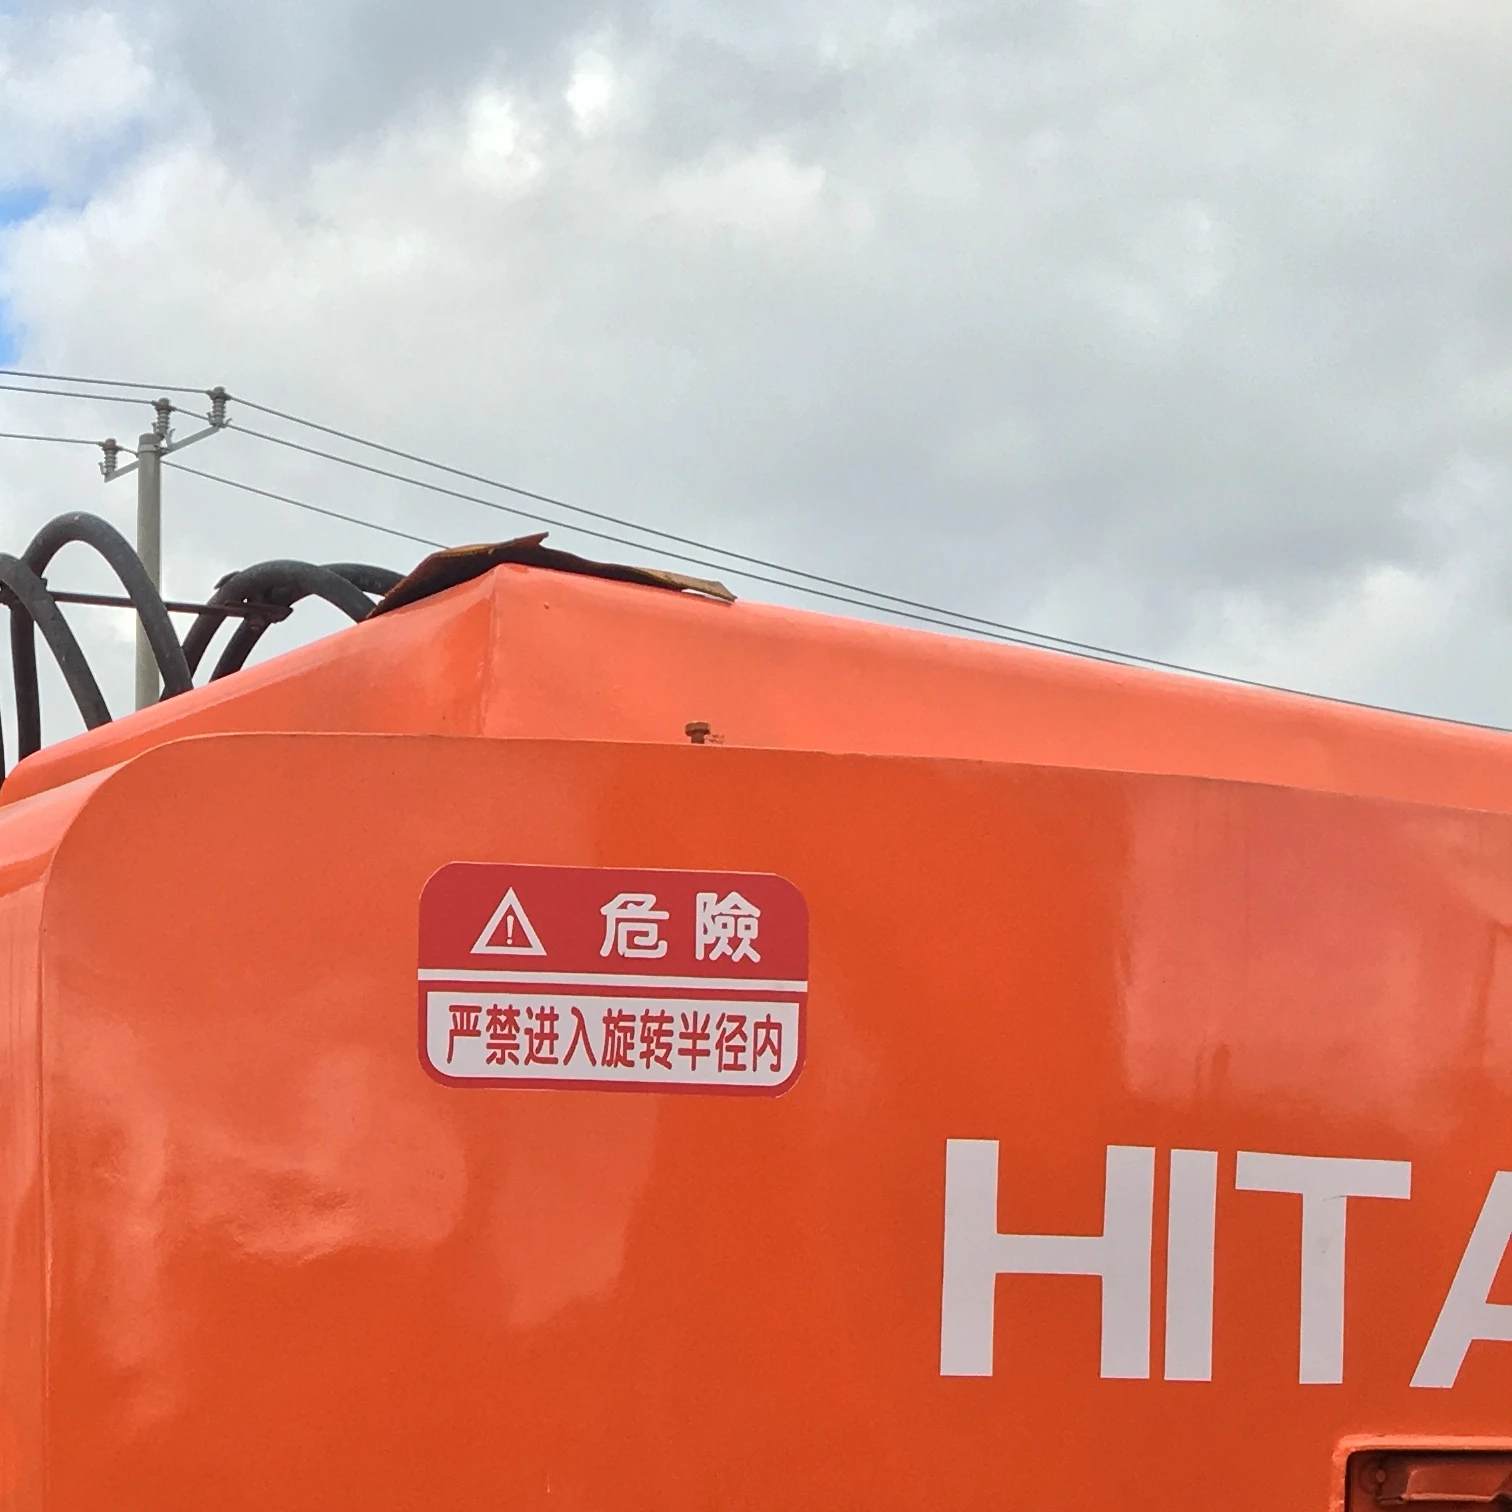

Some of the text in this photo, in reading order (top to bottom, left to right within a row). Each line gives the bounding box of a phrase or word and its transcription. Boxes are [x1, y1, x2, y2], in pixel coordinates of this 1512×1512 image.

[600, 891, 761, 963] 危險
[446, 1003, 783, 1073] 严禁进入旋转半径内
